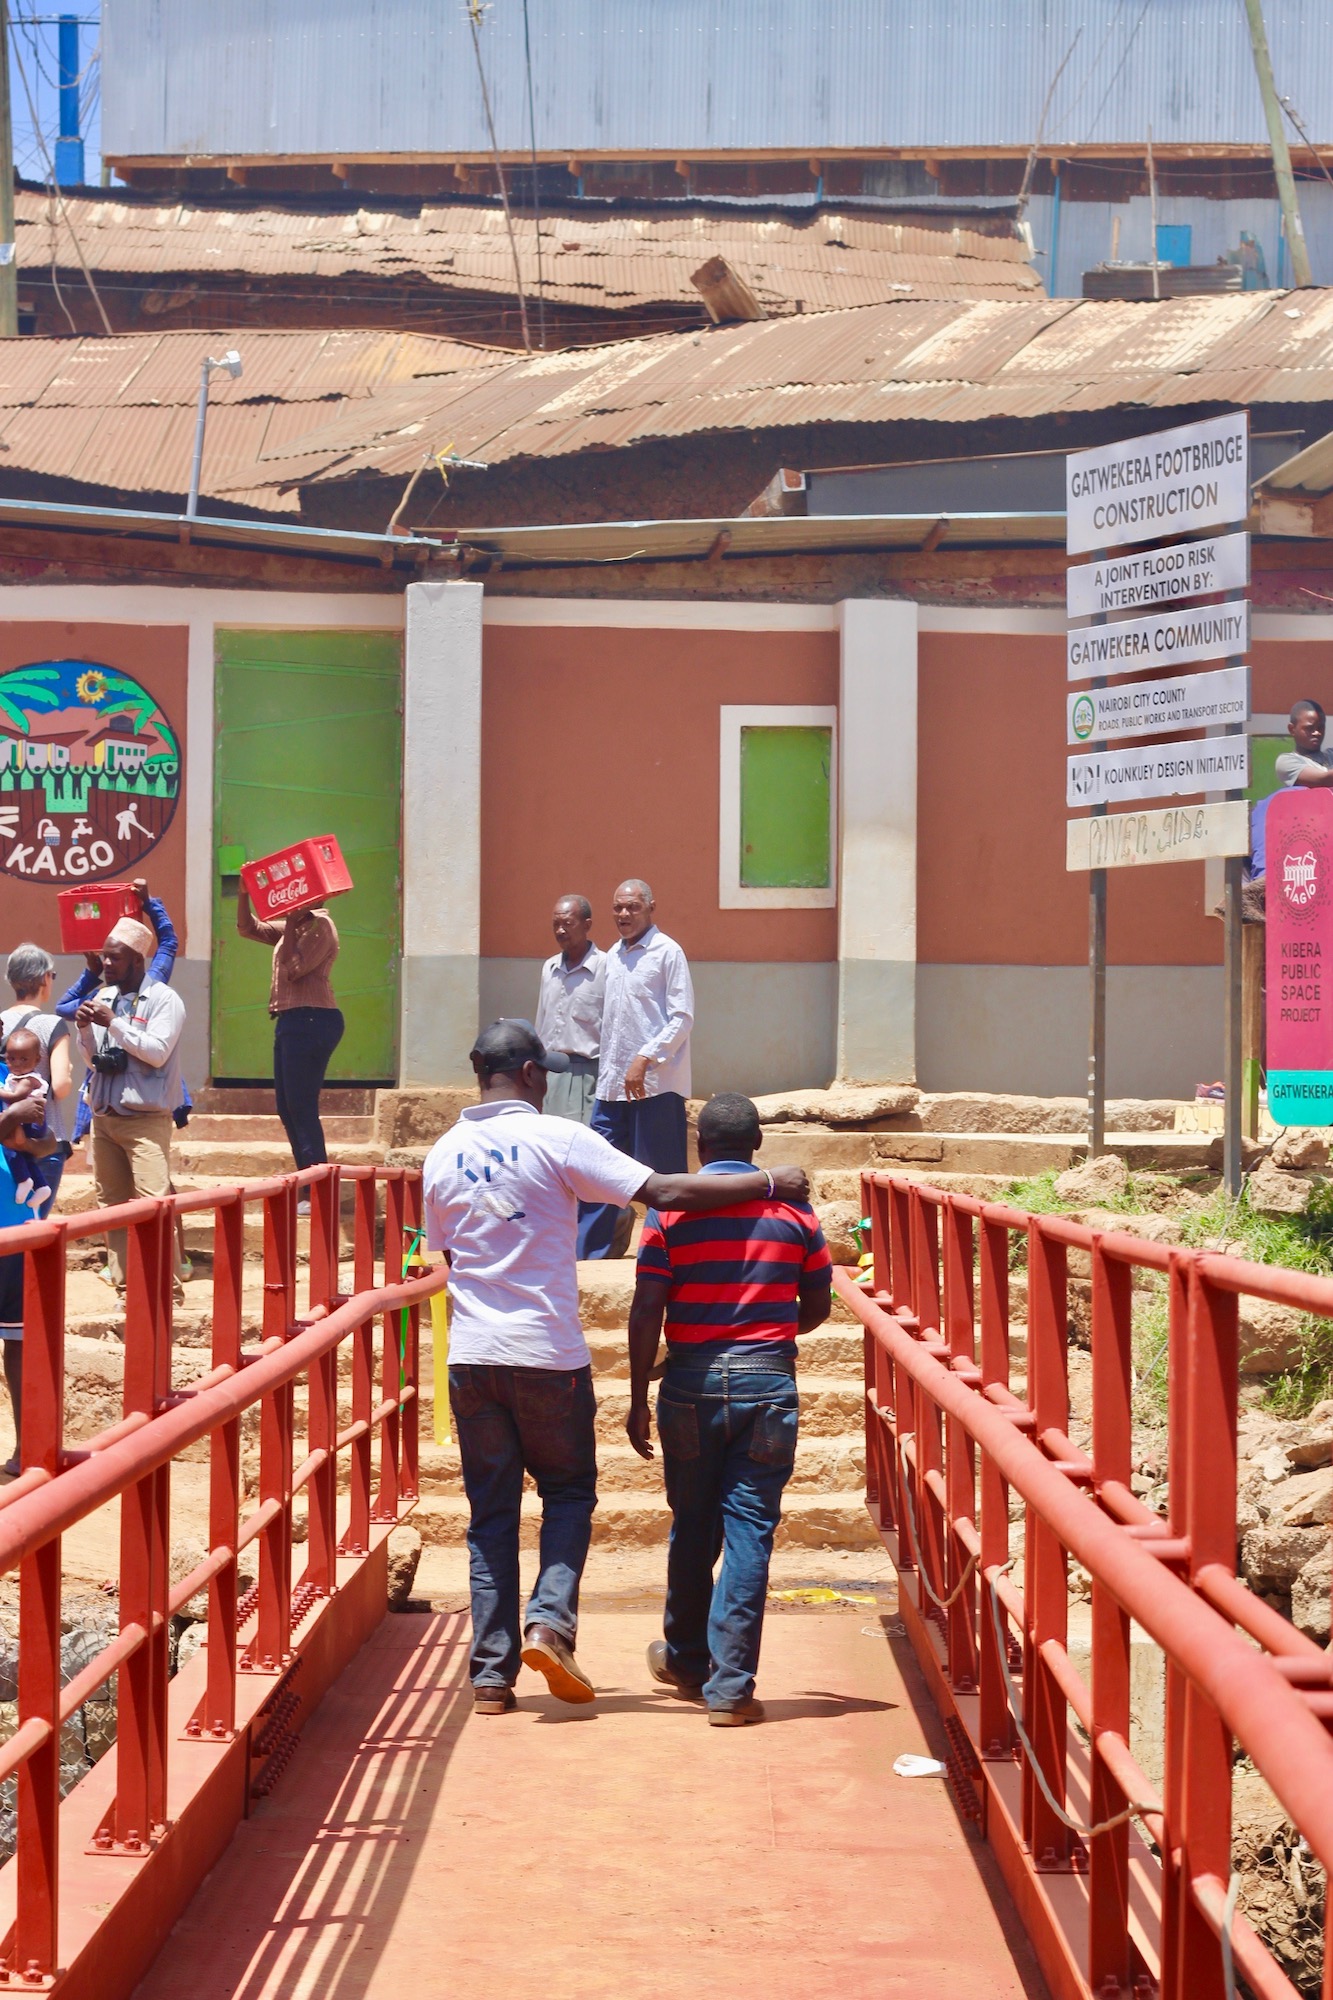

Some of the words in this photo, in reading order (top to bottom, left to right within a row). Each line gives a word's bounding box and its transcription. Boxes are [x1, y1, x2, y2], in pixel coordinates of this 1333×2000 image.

[1071, 461, 1152, 498] GATWEKERA
[1155, 435, 1243, 480] FOOTBRIDGE
[1093, 482, 1218, 530] CONSTRUCTION
[1094, 574, 1103, 587] A
[1105, 562, 1140, 588] JOINT
[1143, 553, 1184, 577] FLOOD
[1188, 546, 1216, 567] RISK
[1100, 576, 1191, 609] INTERVENTION
[1193, 571, 1213, 591] BY:
[1070, 632, 1150, 665] GATWEKERA
[1153, 616, 1243, 652] COMMUNITY
[1098, 698, 1132, 714] NAIROBI
[1133, 692, 1151, 708] CITY
[1153, 688, 1186, 706] COUNTY
[1122, 716, 1143, 728] PUBLIC
[1144, 713, 1166, 725] WORKS
[1167, 710, 1181, 722] AND
[1181, 704, 1218, 720] TRANSPORT
[1219, 700, 1244, 715] SECTOR
[1104, 764, 1155, 785] KOUNKUEY
[1157, 759, 1194, 779] DESIGN
[1196, 754, 1245, 775] INITIATIVE
[1281, 942, 1322, 958] KIBERA
[1281, 963, 1321, 980] PUBLIC
[1281, 984, 1321, 1001] SPACE
[1280, 1008, 1321, 1023] PROJECT
[1273, 1084, 1333, 1099] GATWEKERA
